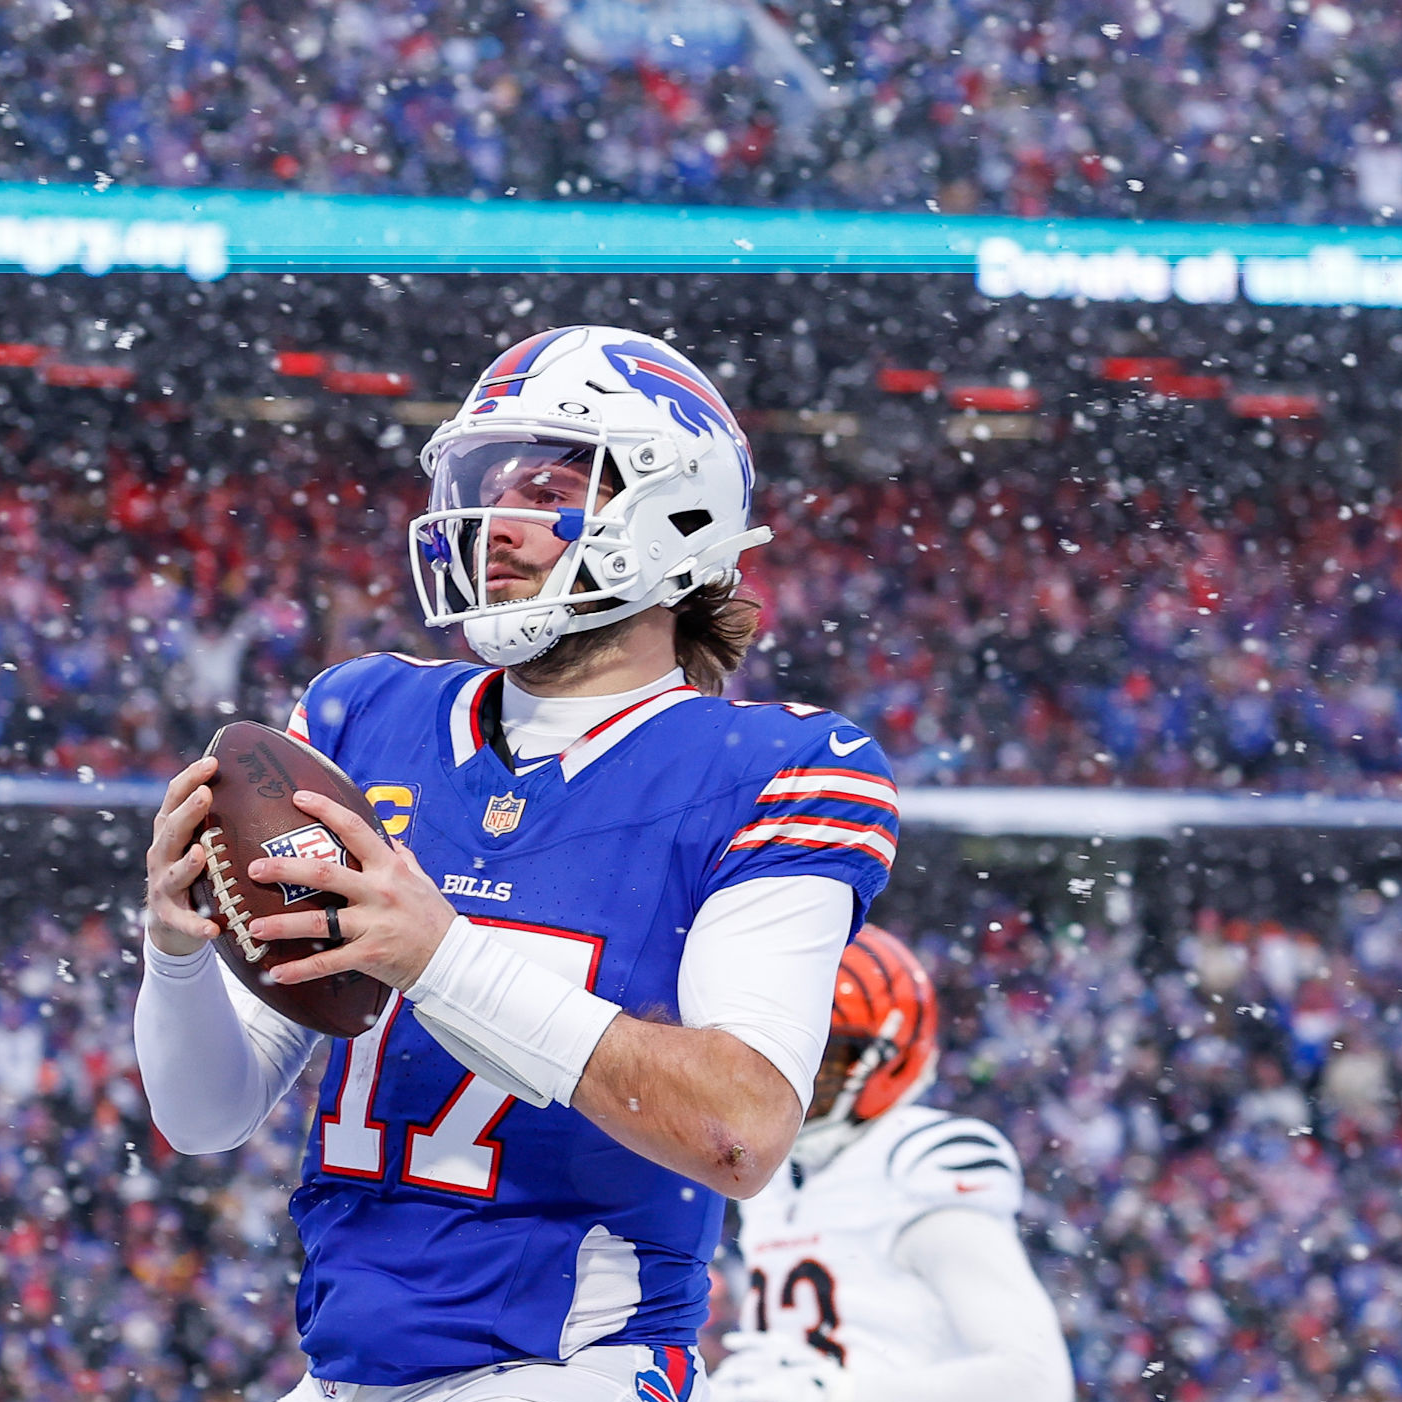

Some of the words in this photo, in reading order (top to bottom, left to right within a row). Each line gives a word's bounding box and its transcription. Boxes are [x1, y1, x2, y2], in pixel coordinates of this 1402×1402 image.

[975, 236, 1171, 303] Donate
[1172, 248, 1239, 304] at
[364, 785, 414, 836] C
[488, 812, 512, 829] NFL
[440, 874, 513, 902] BILLS
[321, 912, 608, 1201] 17
